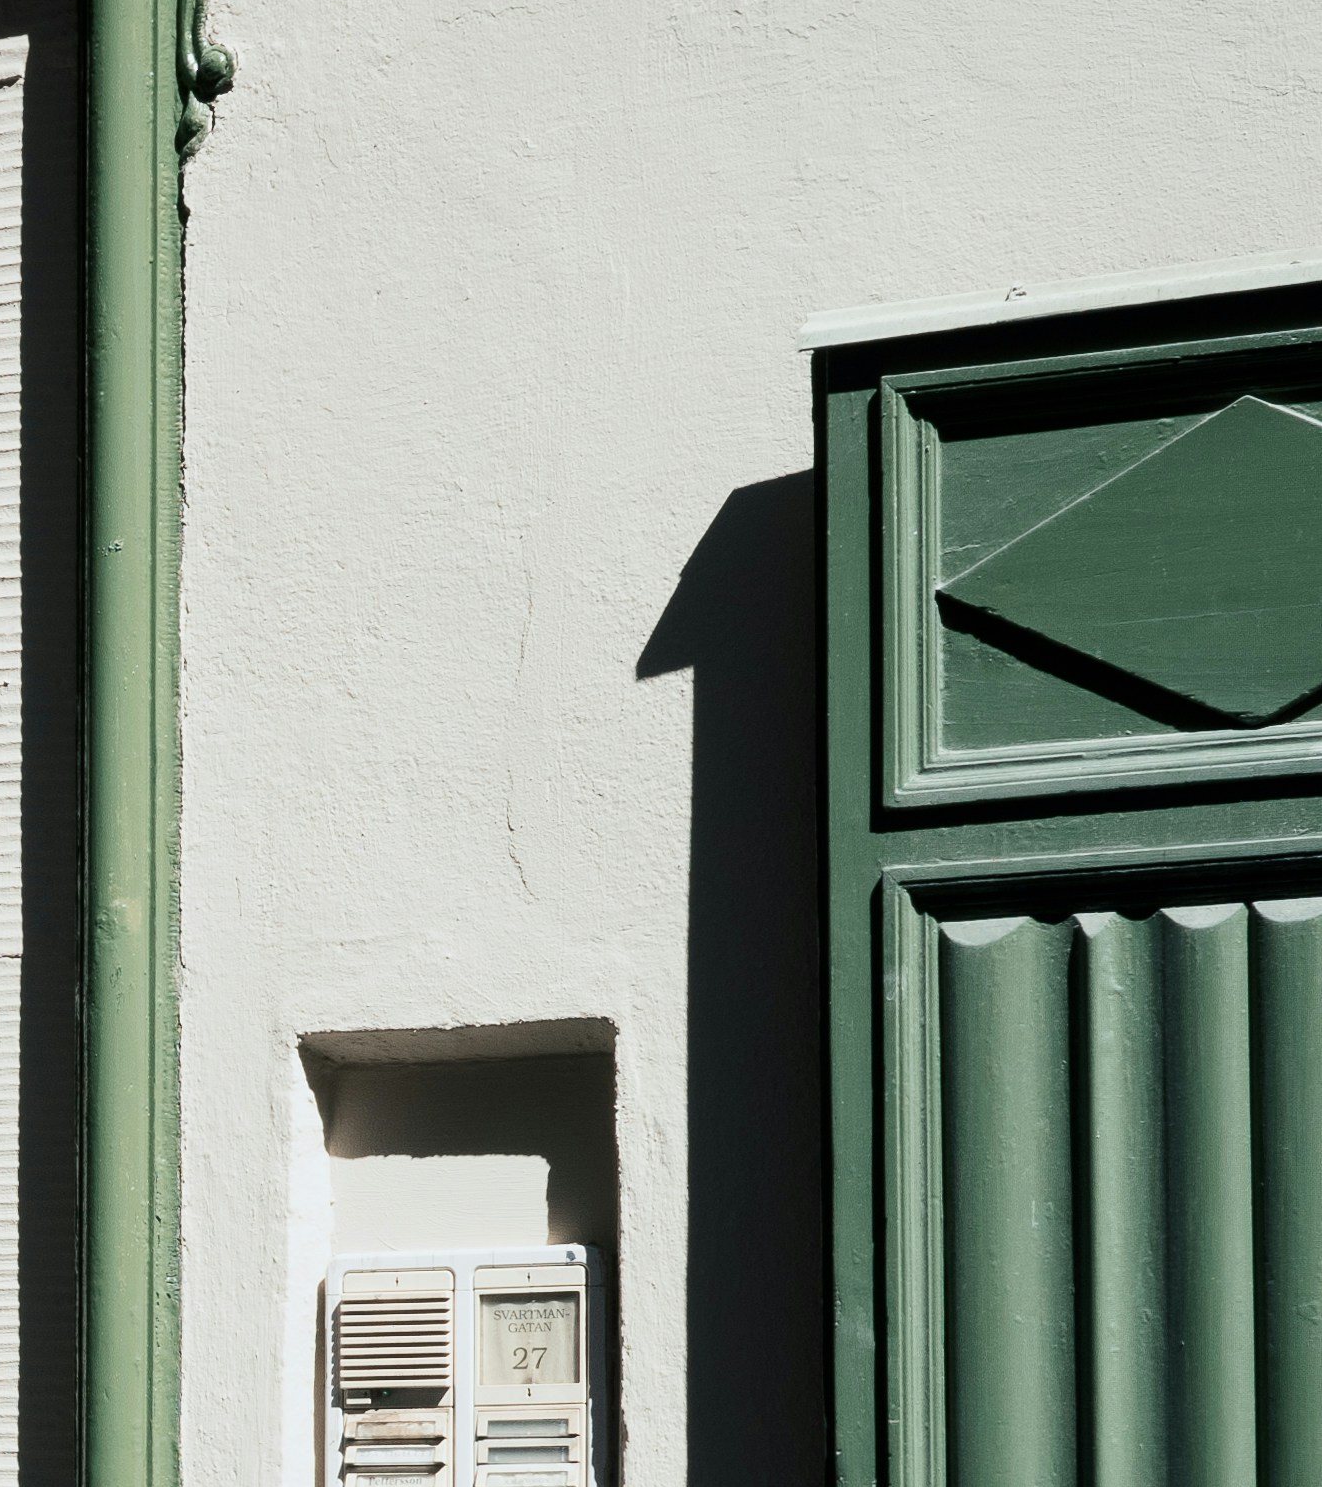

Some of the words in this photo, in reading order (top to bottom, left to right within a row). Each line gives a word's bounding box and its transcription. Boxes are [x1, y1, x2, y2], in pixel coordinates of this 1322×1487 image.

[493, 1308, 571, 1320] SVARTMAN-
[508, 1321, 553, 1333] GATAN
[512, 1347, 548, 1370] 27
